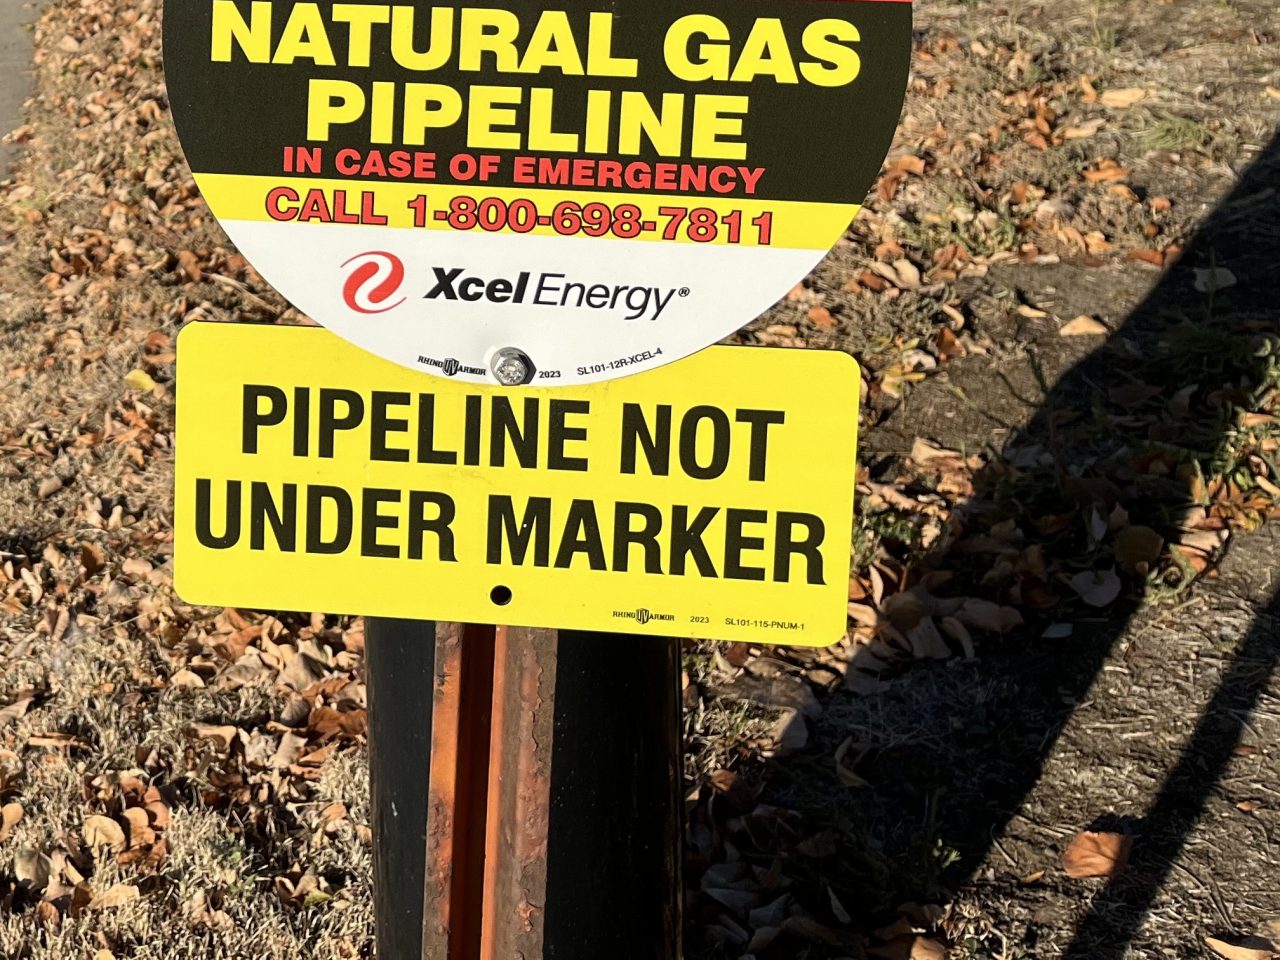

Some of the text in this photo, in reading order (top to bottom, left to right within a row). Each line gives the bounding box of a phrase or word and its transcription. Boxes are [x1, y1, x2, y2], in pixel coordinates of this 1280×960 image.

[211, 0, 861, 87] NATURAL GAS
[306, 79, 750, 161] PIPELINE
[283, 146, 766, 194] IN CASE OF EMERGENCY
[265, 186, 773, 245] CALL 1-800-698-7811
[538, 370, 561, 379] 2023
[576, 347, 663, 376] SL101-12R-XCEL-4
[242, 383, 786, 482] PIPELINE NOT
[194, 478, 827, 586] UNDER MARKER
[690, 615, 710, 624] 2023
